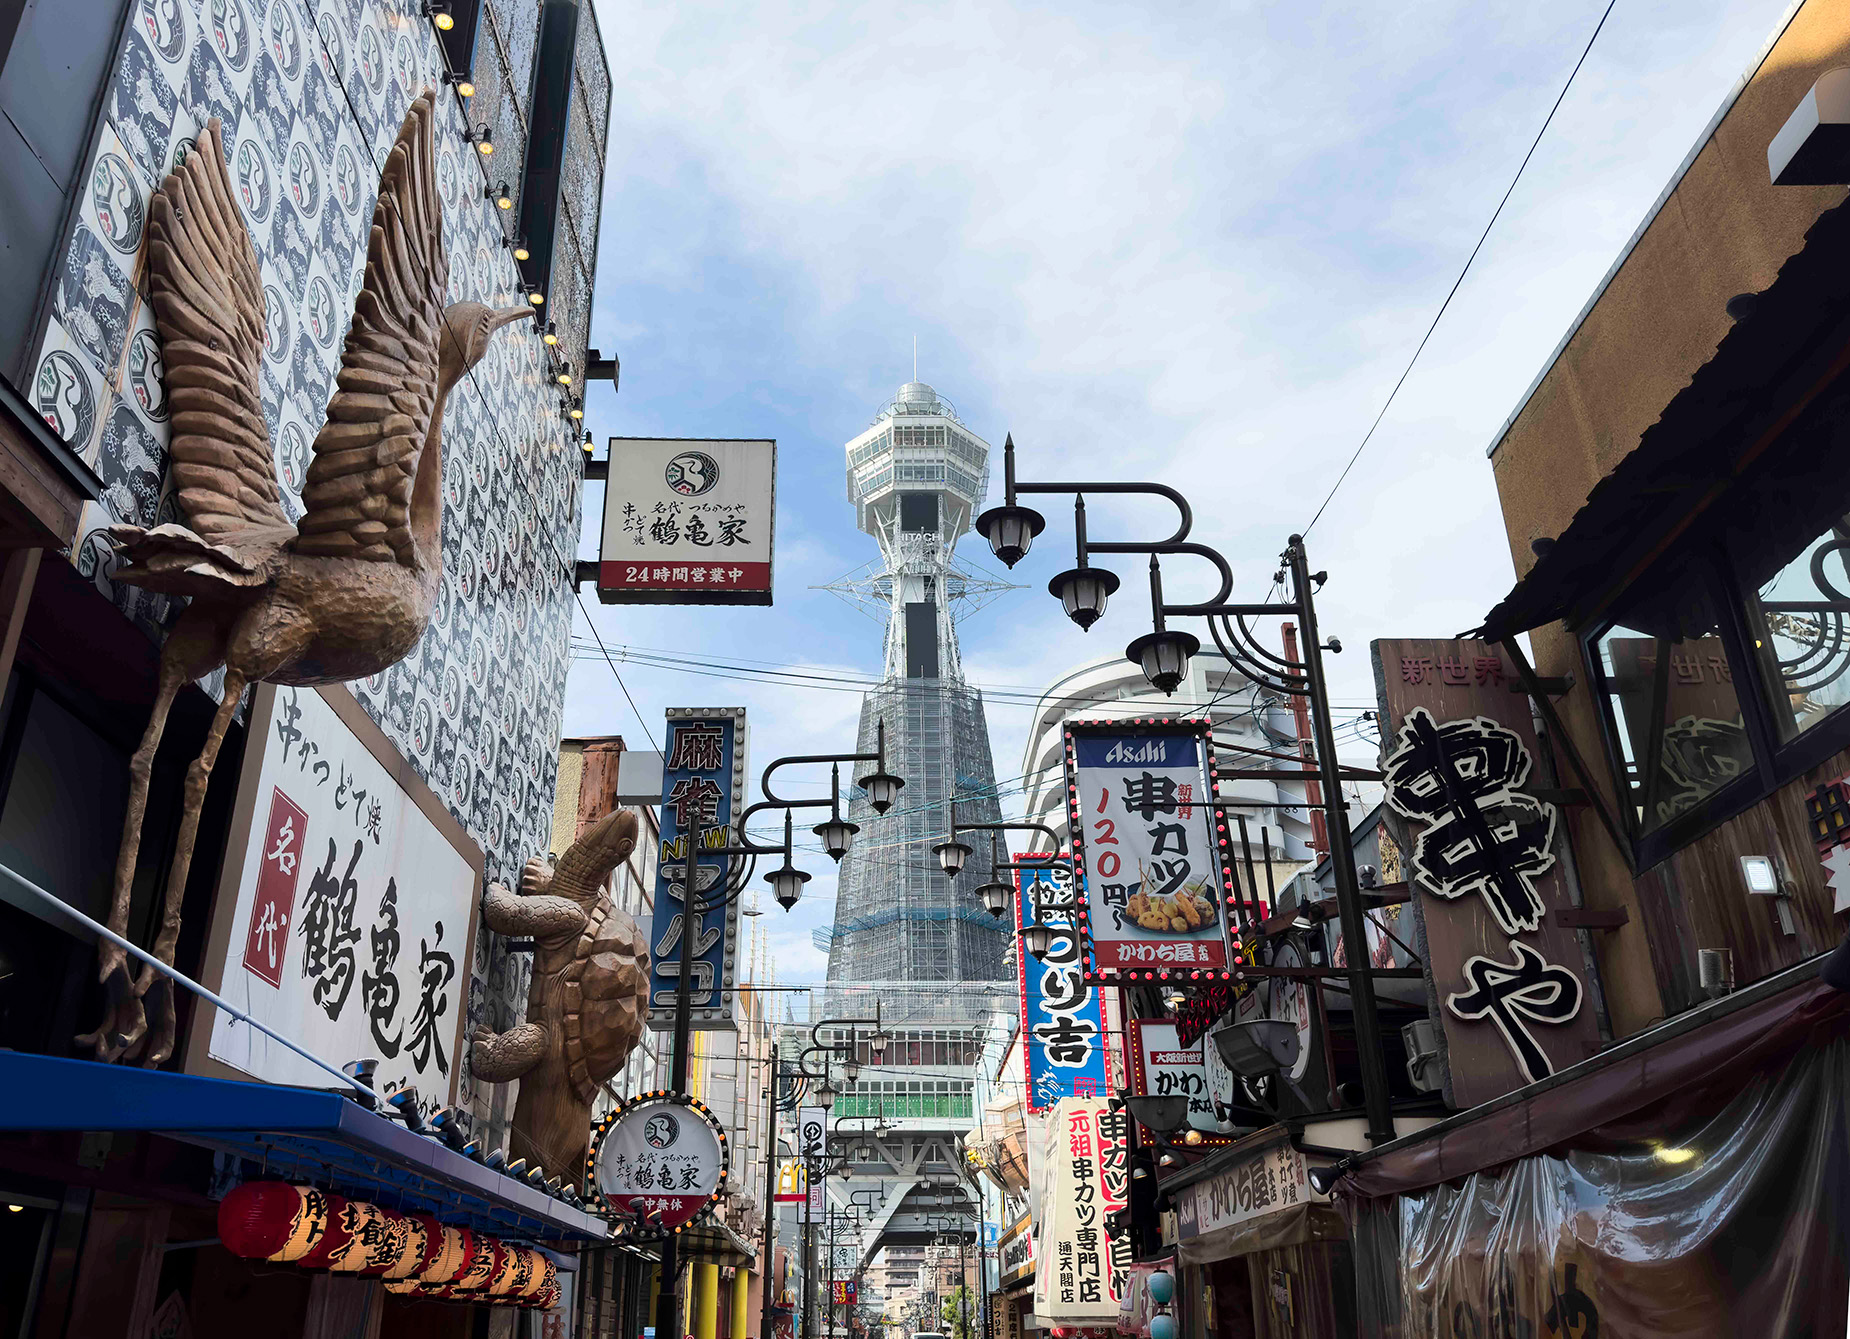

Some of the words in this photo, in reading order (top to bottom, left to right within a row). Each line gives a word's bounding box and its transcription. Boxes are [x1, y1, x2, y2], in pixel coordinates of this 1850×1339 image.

[648, 513, 752, 547] 鶴亀家
[625, 566, 744, 584] 24時間営業中
[1401, 656, 1504, 686] 新世界
[1105, 740, 1167, 764] Asahi
[665, 722, 725, 827] 麻雀
[1121, 771, 1191, 895] 串カツ
[298, 836, 456, 1079] 鶴亀家
[1116, 943, 1197, 963] かわち屋
[1155, 1070, 1208, 1096] かわ
[633, 1163, 702, 1190] 鶴亀家
[1210, 1156, 1270, 1221] かわち屋
[644, 1197, 684, 1211] 中無休
[1058, 1241, 1075, 1304] 通天閣店
